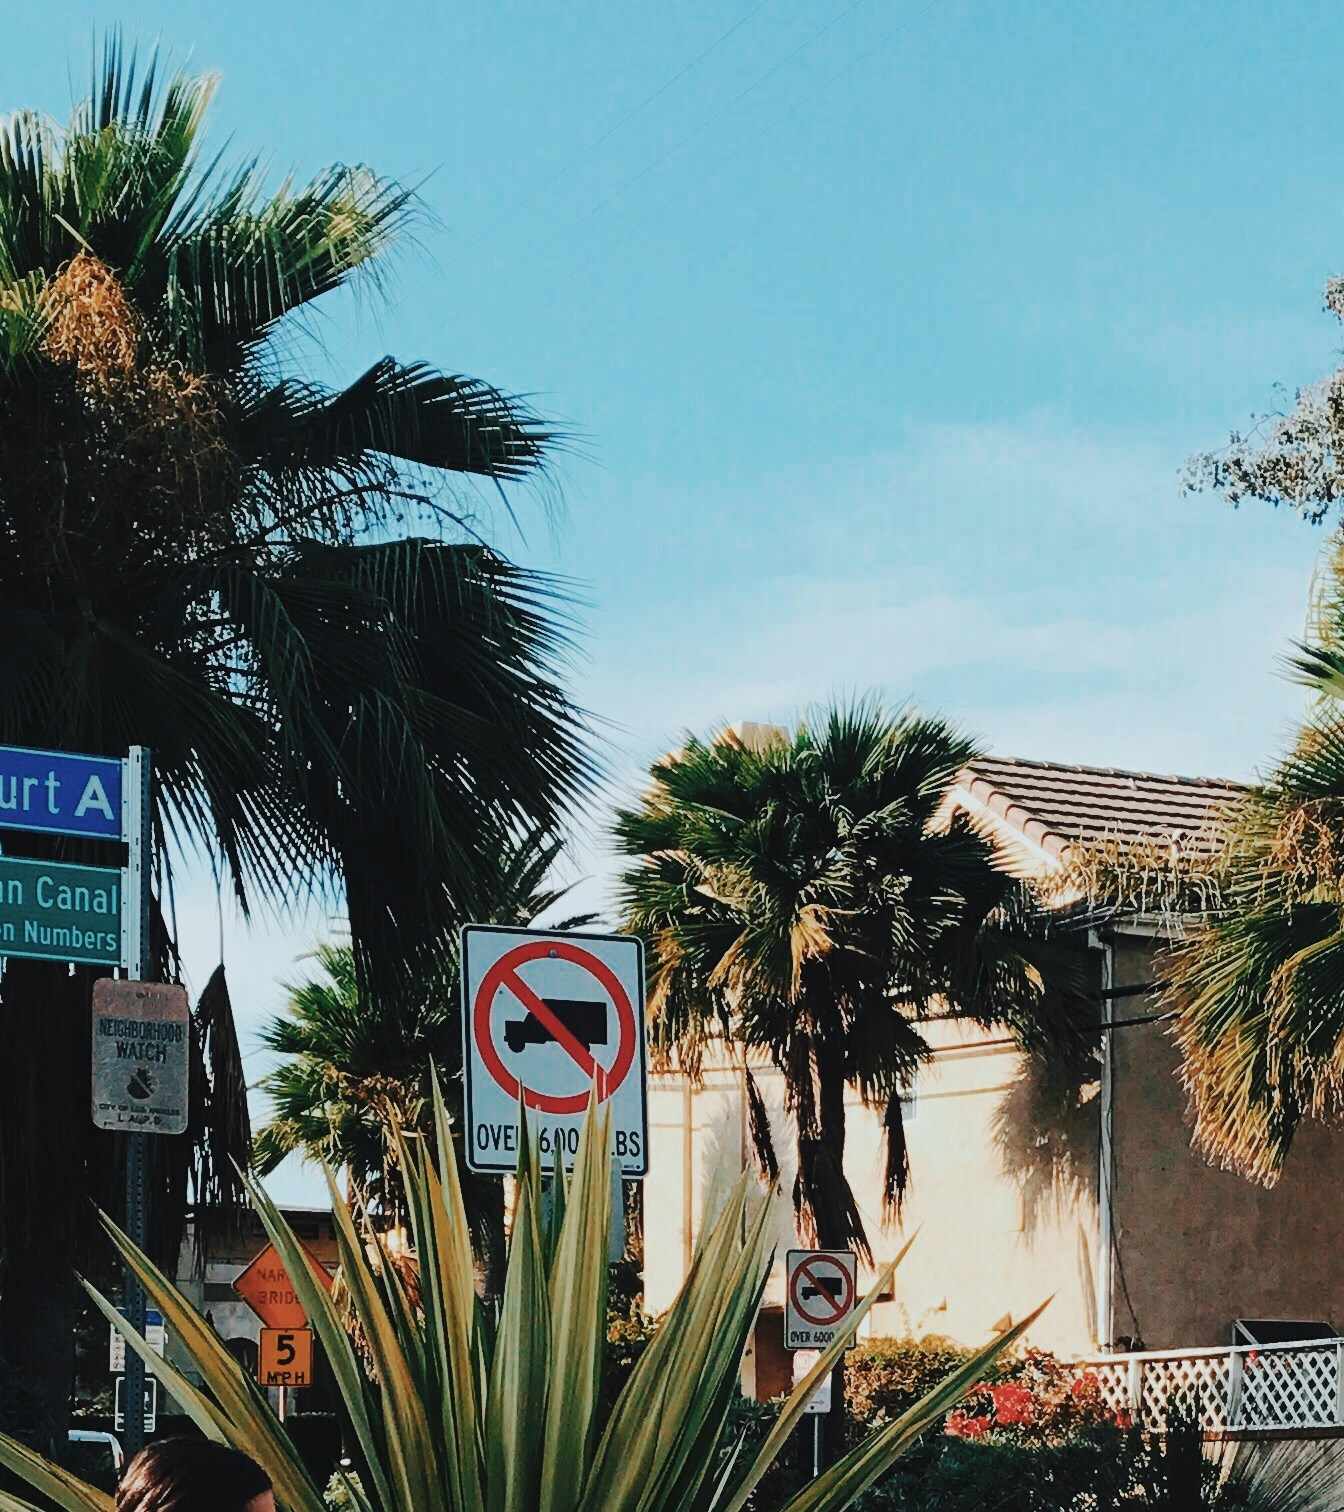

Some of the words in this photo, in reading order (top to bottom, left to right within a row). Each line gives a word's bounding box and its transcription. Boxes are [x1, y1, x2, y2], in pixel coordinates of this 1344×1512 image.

[74, 775, 114, 820] A
[36, 876, 118, 916] Canal
[24, 920, 117, 952] Numbers
[99, 1018, 182, 1042] NEIGHBORHOOD
[116, 1040, 167, 1063] WATCH
[477, 1123, 519, 1151] OVE
[611, 1130, 641, 1157] BS
[257, 1268, 286, 1281] NAR
[258, 1290, 300, 1304] BRID
[790, 1331, 811, 1343] OVER
[277, 1334, 296, 1365] 5
[267, 1371, 305, 1384] MPH
